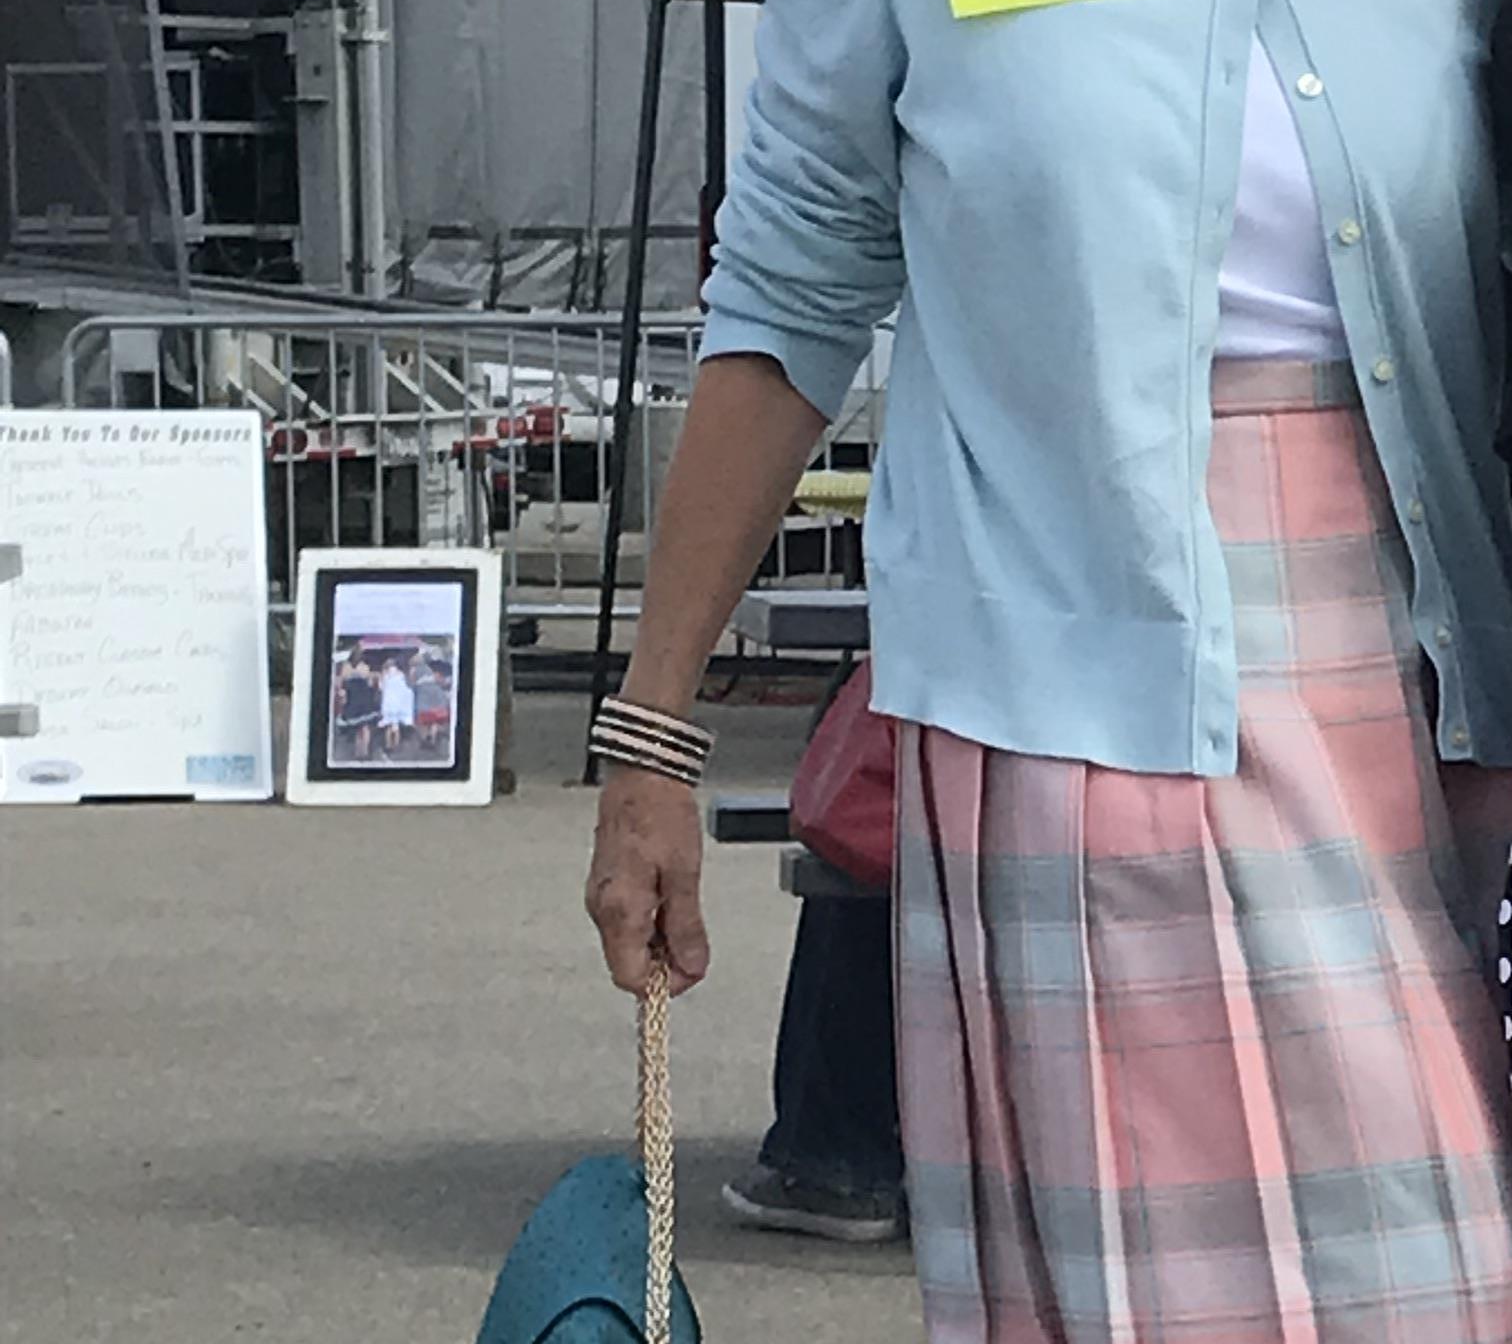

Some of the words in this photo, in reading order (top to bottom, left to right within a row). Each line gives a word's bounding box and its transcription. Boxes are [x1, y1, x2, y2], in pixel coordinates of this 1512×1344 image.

[62, 425, 91, 442] You
[101, 424, 120, 442] To
[130, 424, 160, 442] Our
[169, 423, 252, 446] Sponsors
